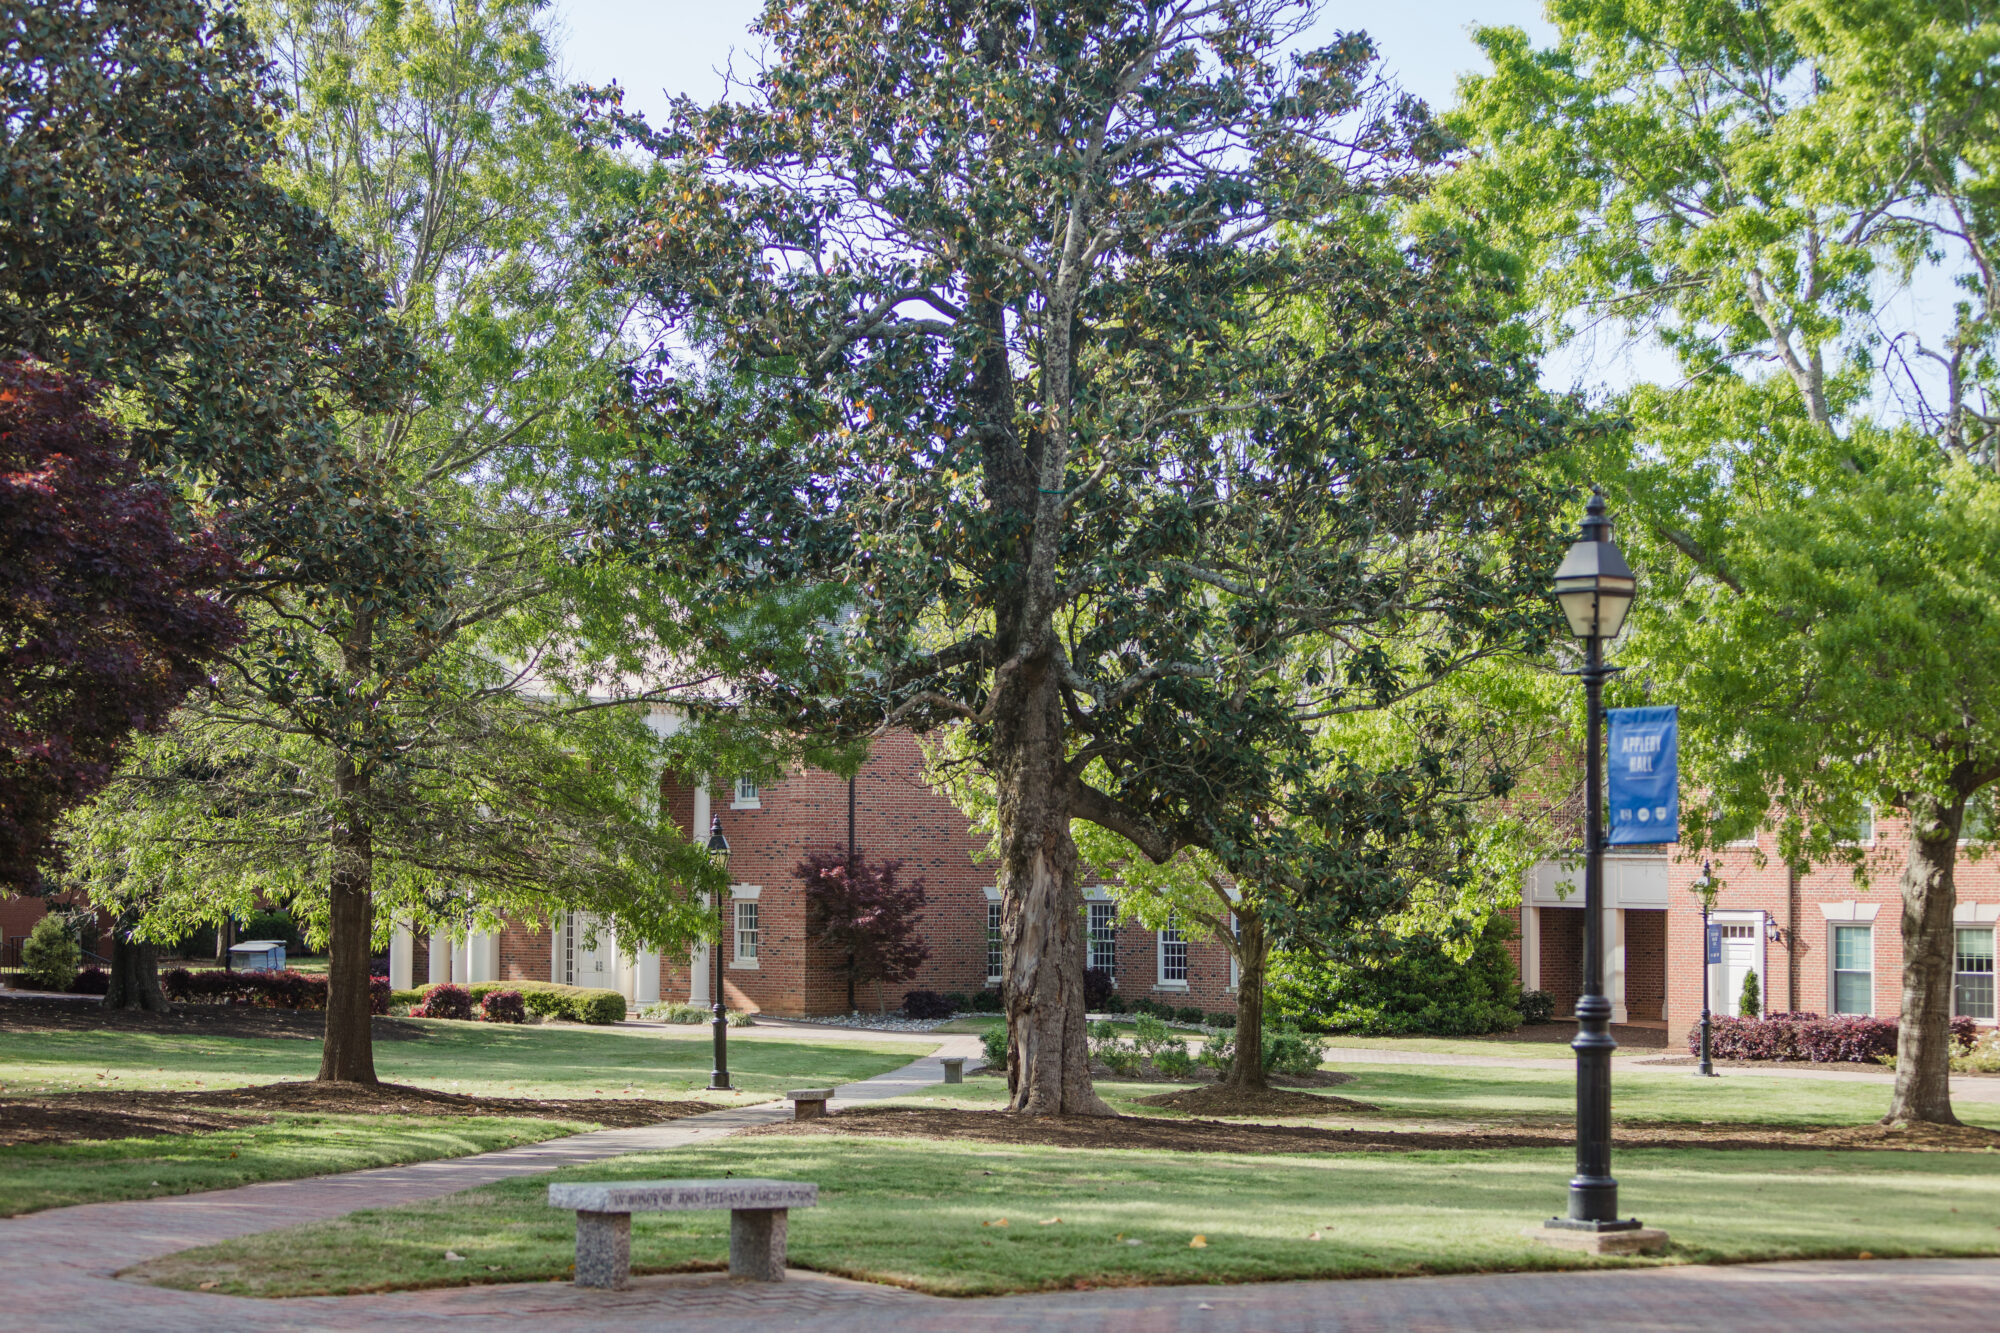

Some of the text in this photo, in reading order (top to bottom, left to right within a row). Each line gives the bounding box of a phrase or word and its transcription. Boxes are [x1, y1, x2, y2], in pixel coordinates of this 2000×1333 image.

[1622, 735, 1661, 753] APPLEBY
[1630, 756, 1653, 772] HALL
[628, 1192, 658, 1206] HONOR
[661, 1192, 673, 1205] OF
